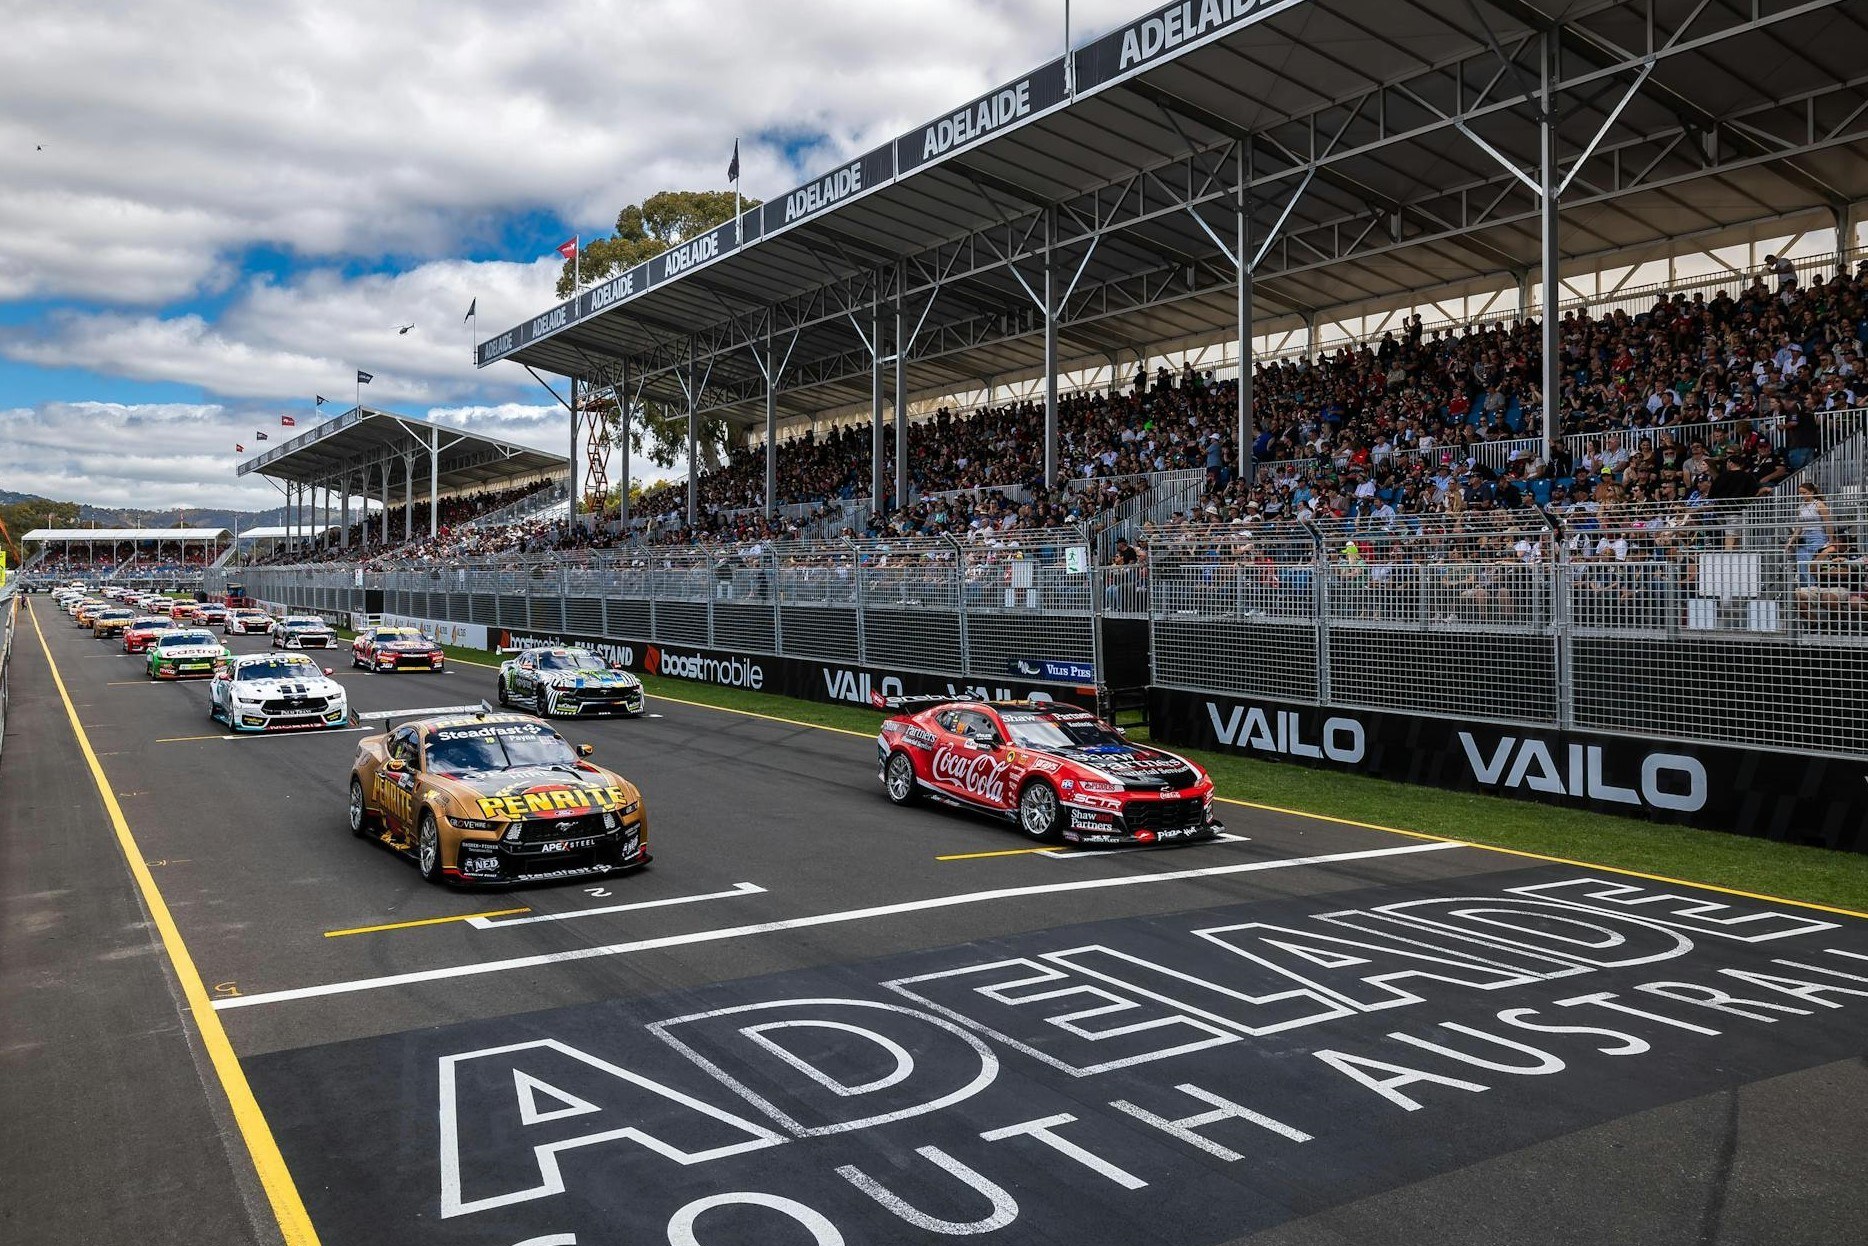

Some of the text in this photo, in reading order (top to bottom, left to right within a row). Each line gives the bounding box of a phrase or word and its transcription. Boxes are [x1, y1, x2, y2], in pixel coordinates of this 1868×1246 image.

[922, 80, 1030, 160] ADELAIDE
[785, 162, 862, 223] ADELAIDE
[664, 232, 719, 278] ADELAIDE
[590, 273, 634, 311] ADELAIDE
[532, 306, 567, 340] ADELAIDE
[484, 332, 513, 360] ADELAIDE
[661, 648, 763, 690] boostmobile
[823, 668, 904, 708] VAILO
[438, 726, 524, 741] Steadfast
[904, 724, 938, 743] Partners
[1001, 714, 1036, 722] Shaw
[1206, 702, 1365, 764] VAILO
[1458, 731, 1708, 812] VAILO
[476, 785, 628, 819] PENRITE
[1070, 809, 1097, 821] Shaw
[1070, 818, 1113, 831] Partners
[569, 838, 596, 849] STEEL
[475, 858, 499, 870] NED
[439, 877, 1843, 1219] ADELAIDE
[510, 1083, 1314, 1246] OUTH
